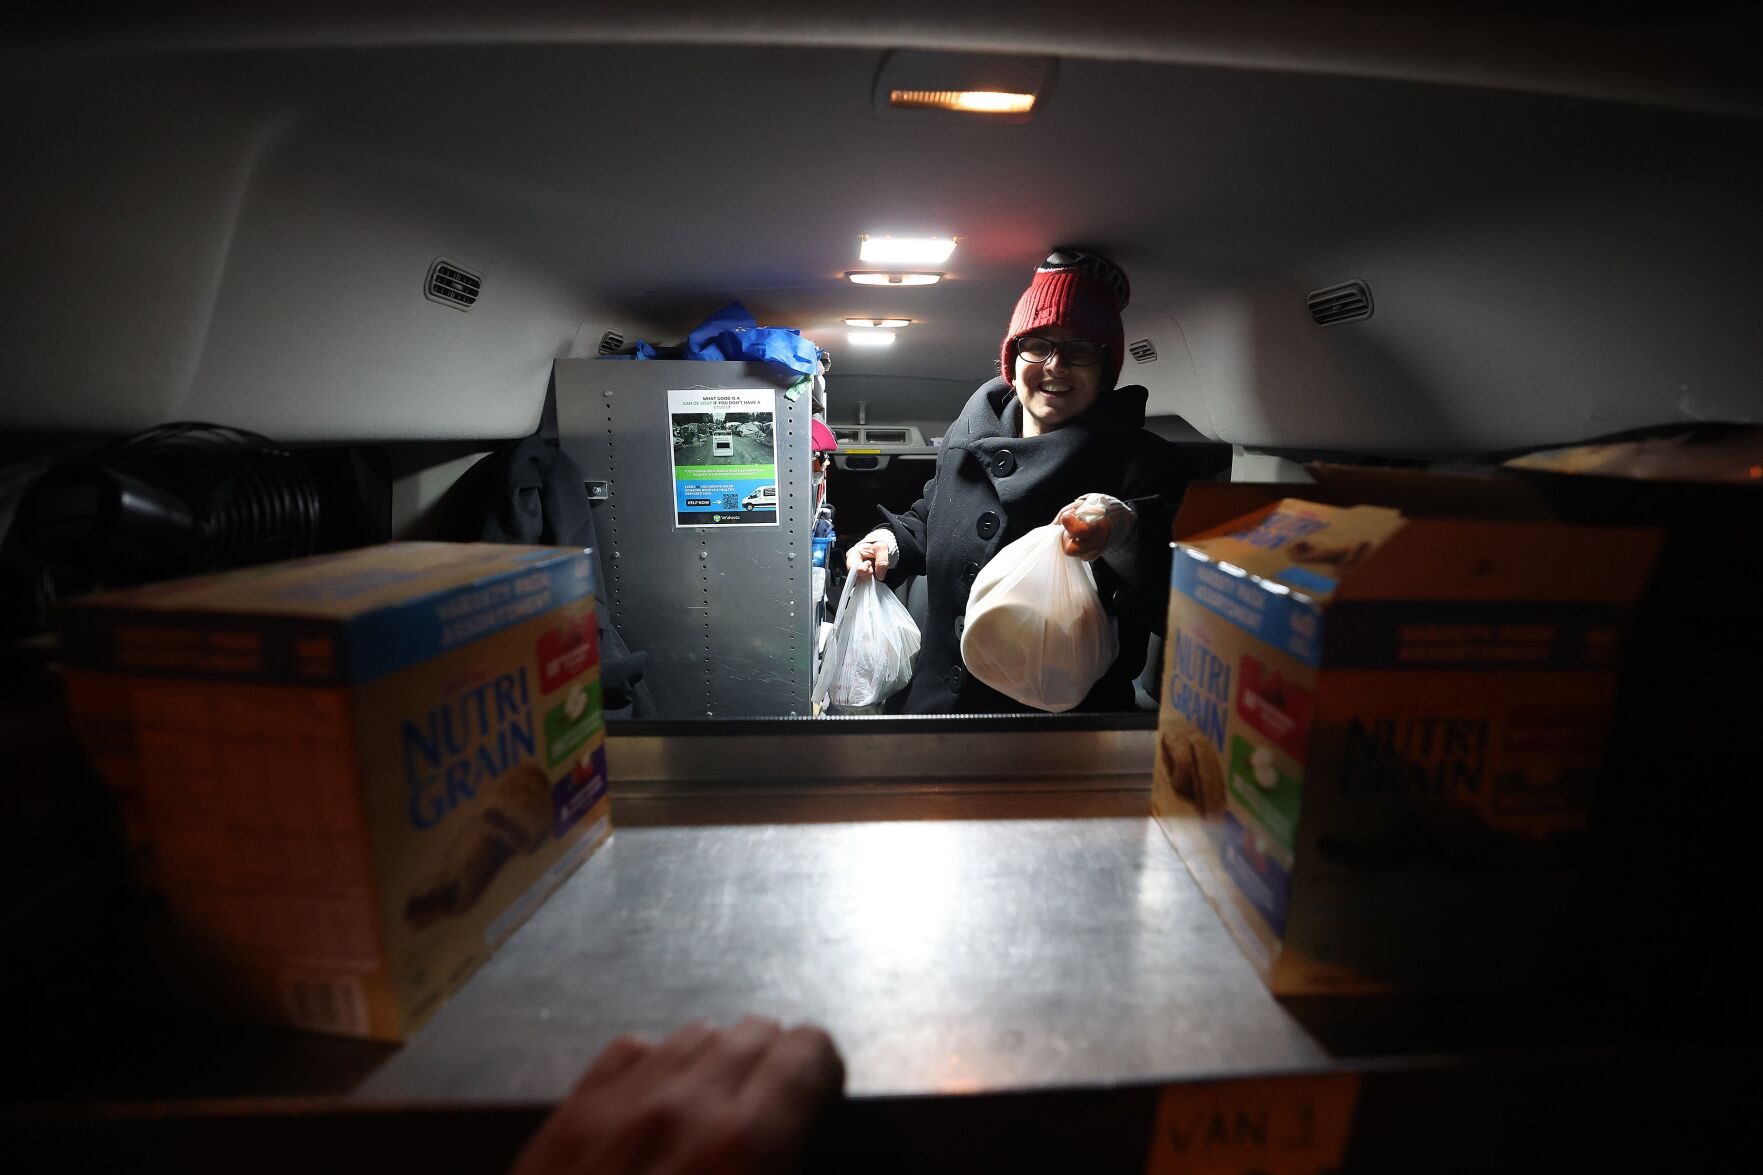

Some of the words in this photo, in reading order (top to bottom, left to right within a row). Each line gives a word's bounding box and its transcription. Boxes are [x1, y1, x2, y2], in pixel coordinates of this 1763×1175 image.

[1169, 673, 1229, 755] GRAIN
[1174, 628, 1232, 704] NUTRI
[402, 667, 529, 781] NUTRI
[409, 713, 535, 830] GRAIN
